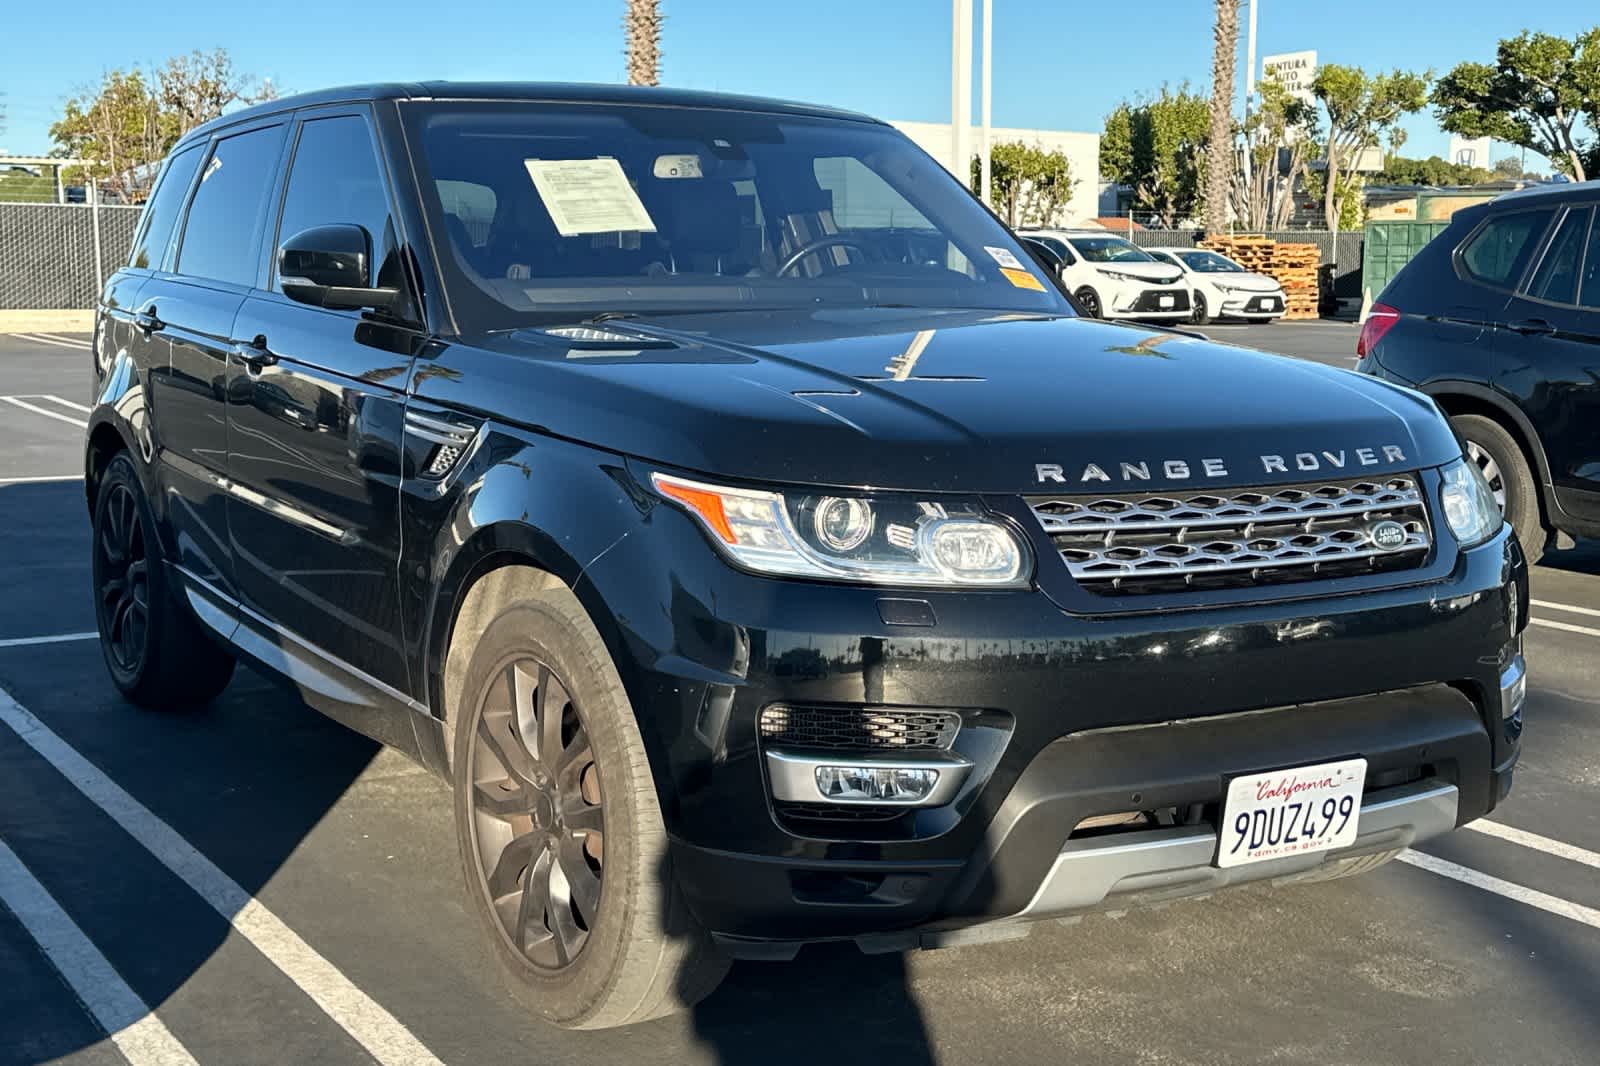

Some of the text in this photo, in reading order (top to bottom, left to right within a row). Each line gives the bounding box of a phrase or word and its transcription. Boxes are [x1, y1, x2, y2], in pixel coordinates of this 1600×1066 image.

[1264, 58, 1307, 71] NTURA
[1273, 70, 1298, 82] AUTO
[1035, 444, 1408, 483] RANGE ROVER
[1379, 527, 1397, 537] LAND
[1382, 534, 1403, 544] ROVER
[1256, 776, 1340, 802] California
[1231, 794, 1354, 855] 9DUZ499
[1253, 838, 1325, 858] dmv.ca.gov
